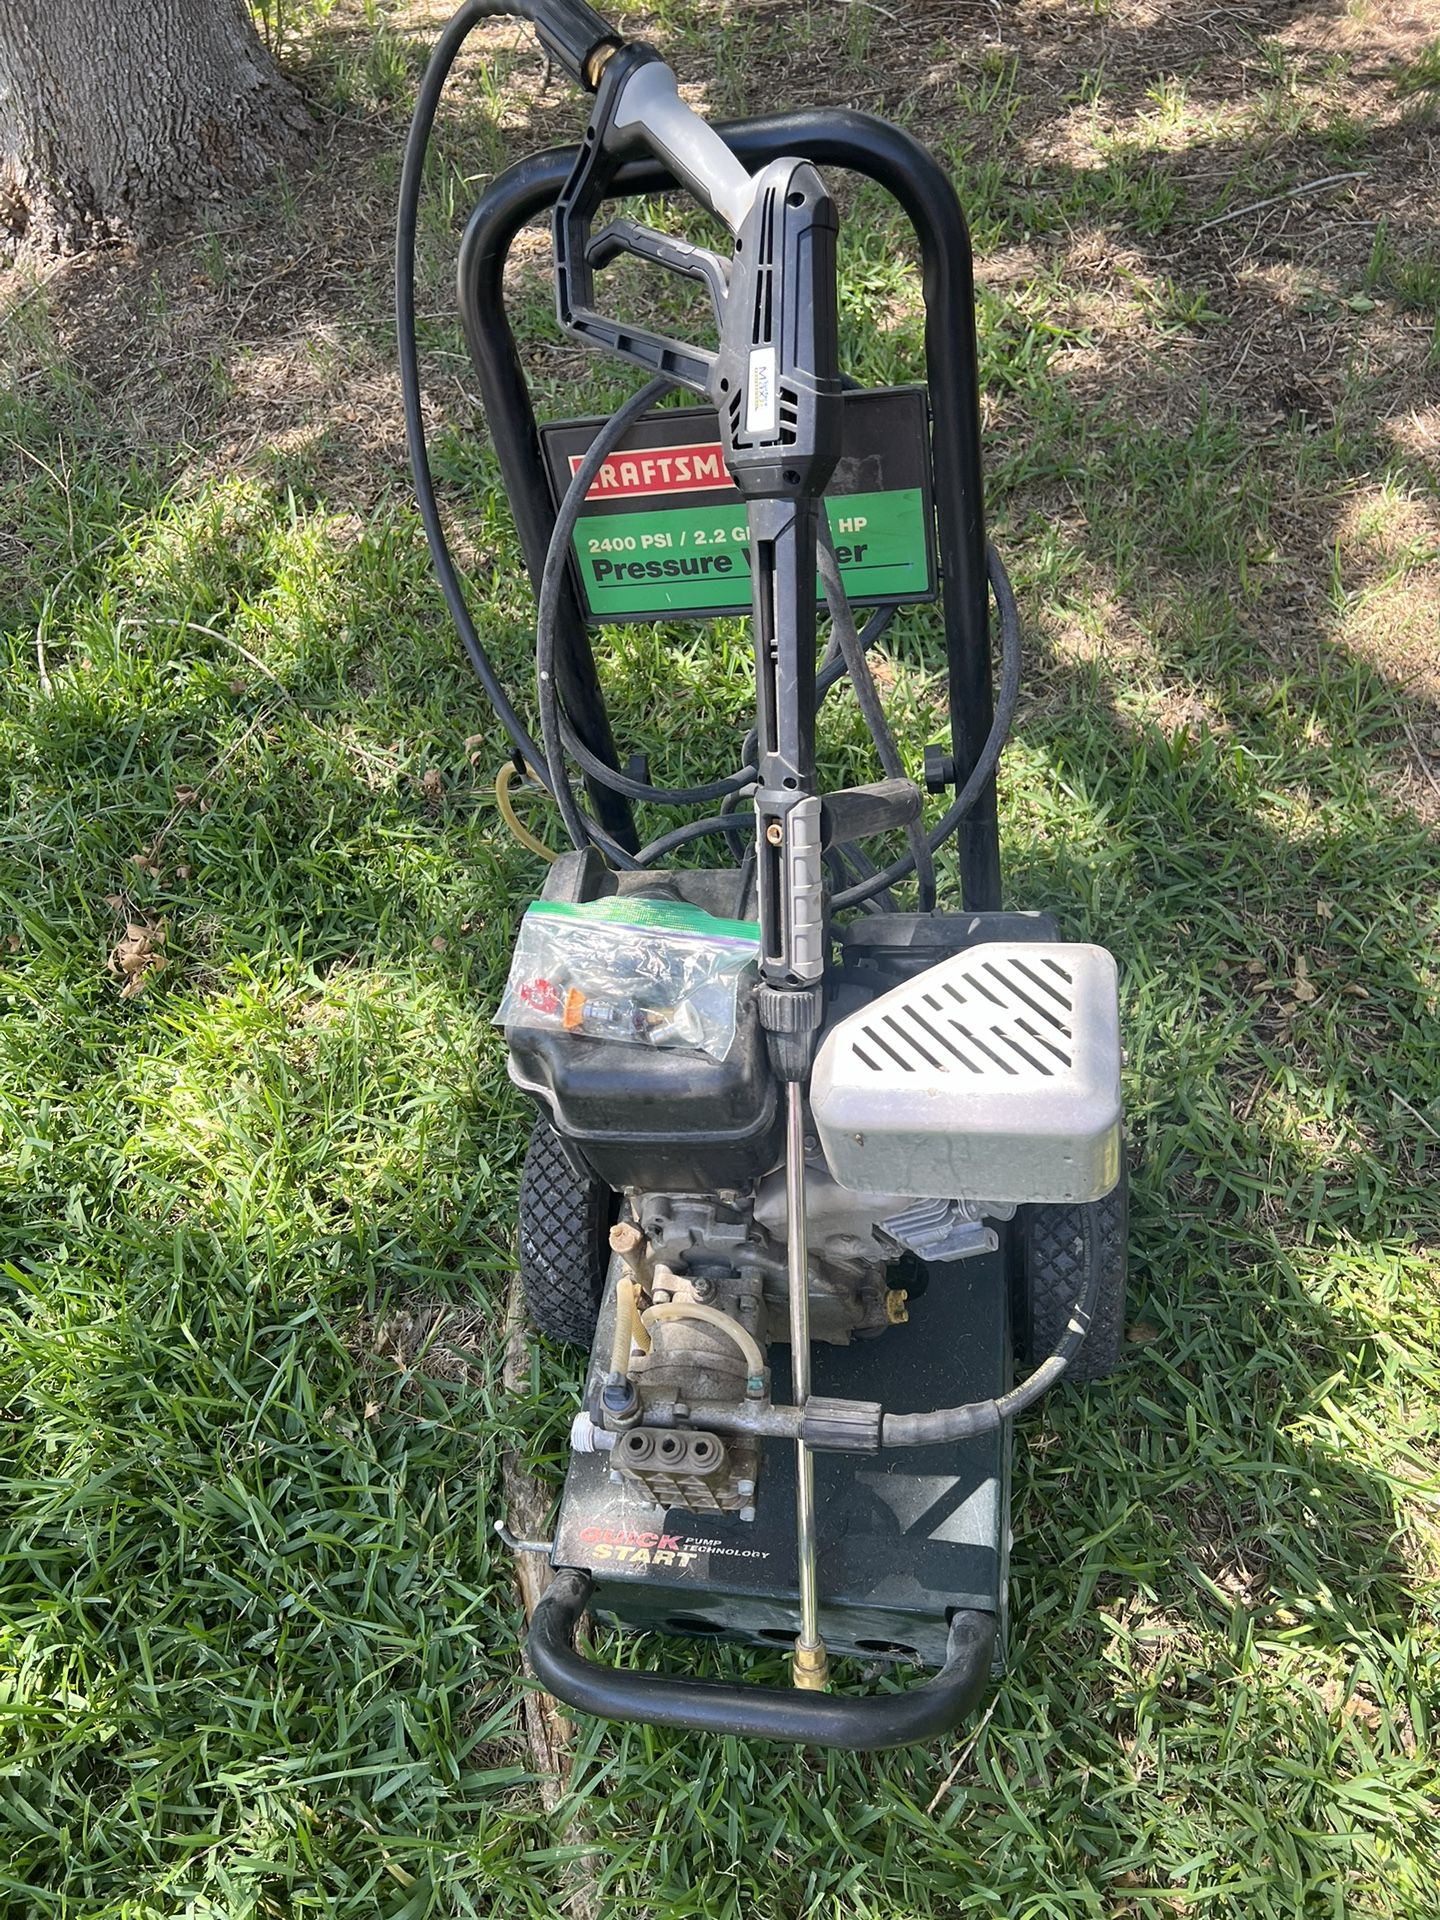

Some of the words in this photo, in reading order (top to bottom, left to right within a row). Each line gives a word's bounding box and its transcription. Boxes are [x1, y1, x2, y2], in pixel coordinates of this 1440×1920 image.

[589, 454, 731, 490] RAFTSM
[588, 536, 636, 554] 2400
[642, 532, 672, 550] PSI
[694, 528, 727, 545] 2.2
[731, 526, 750, 542] G
[838, 517, 868, 533] HP
[592, 556, 733, 582] Pressure
[579, 1526, 685, 1550] QUICK
[684, 1537, 722, 1546] PUMP
[591, 1543, 698, 1568] START
[682, 1544, 771, 1559] TECHNOLOGY
